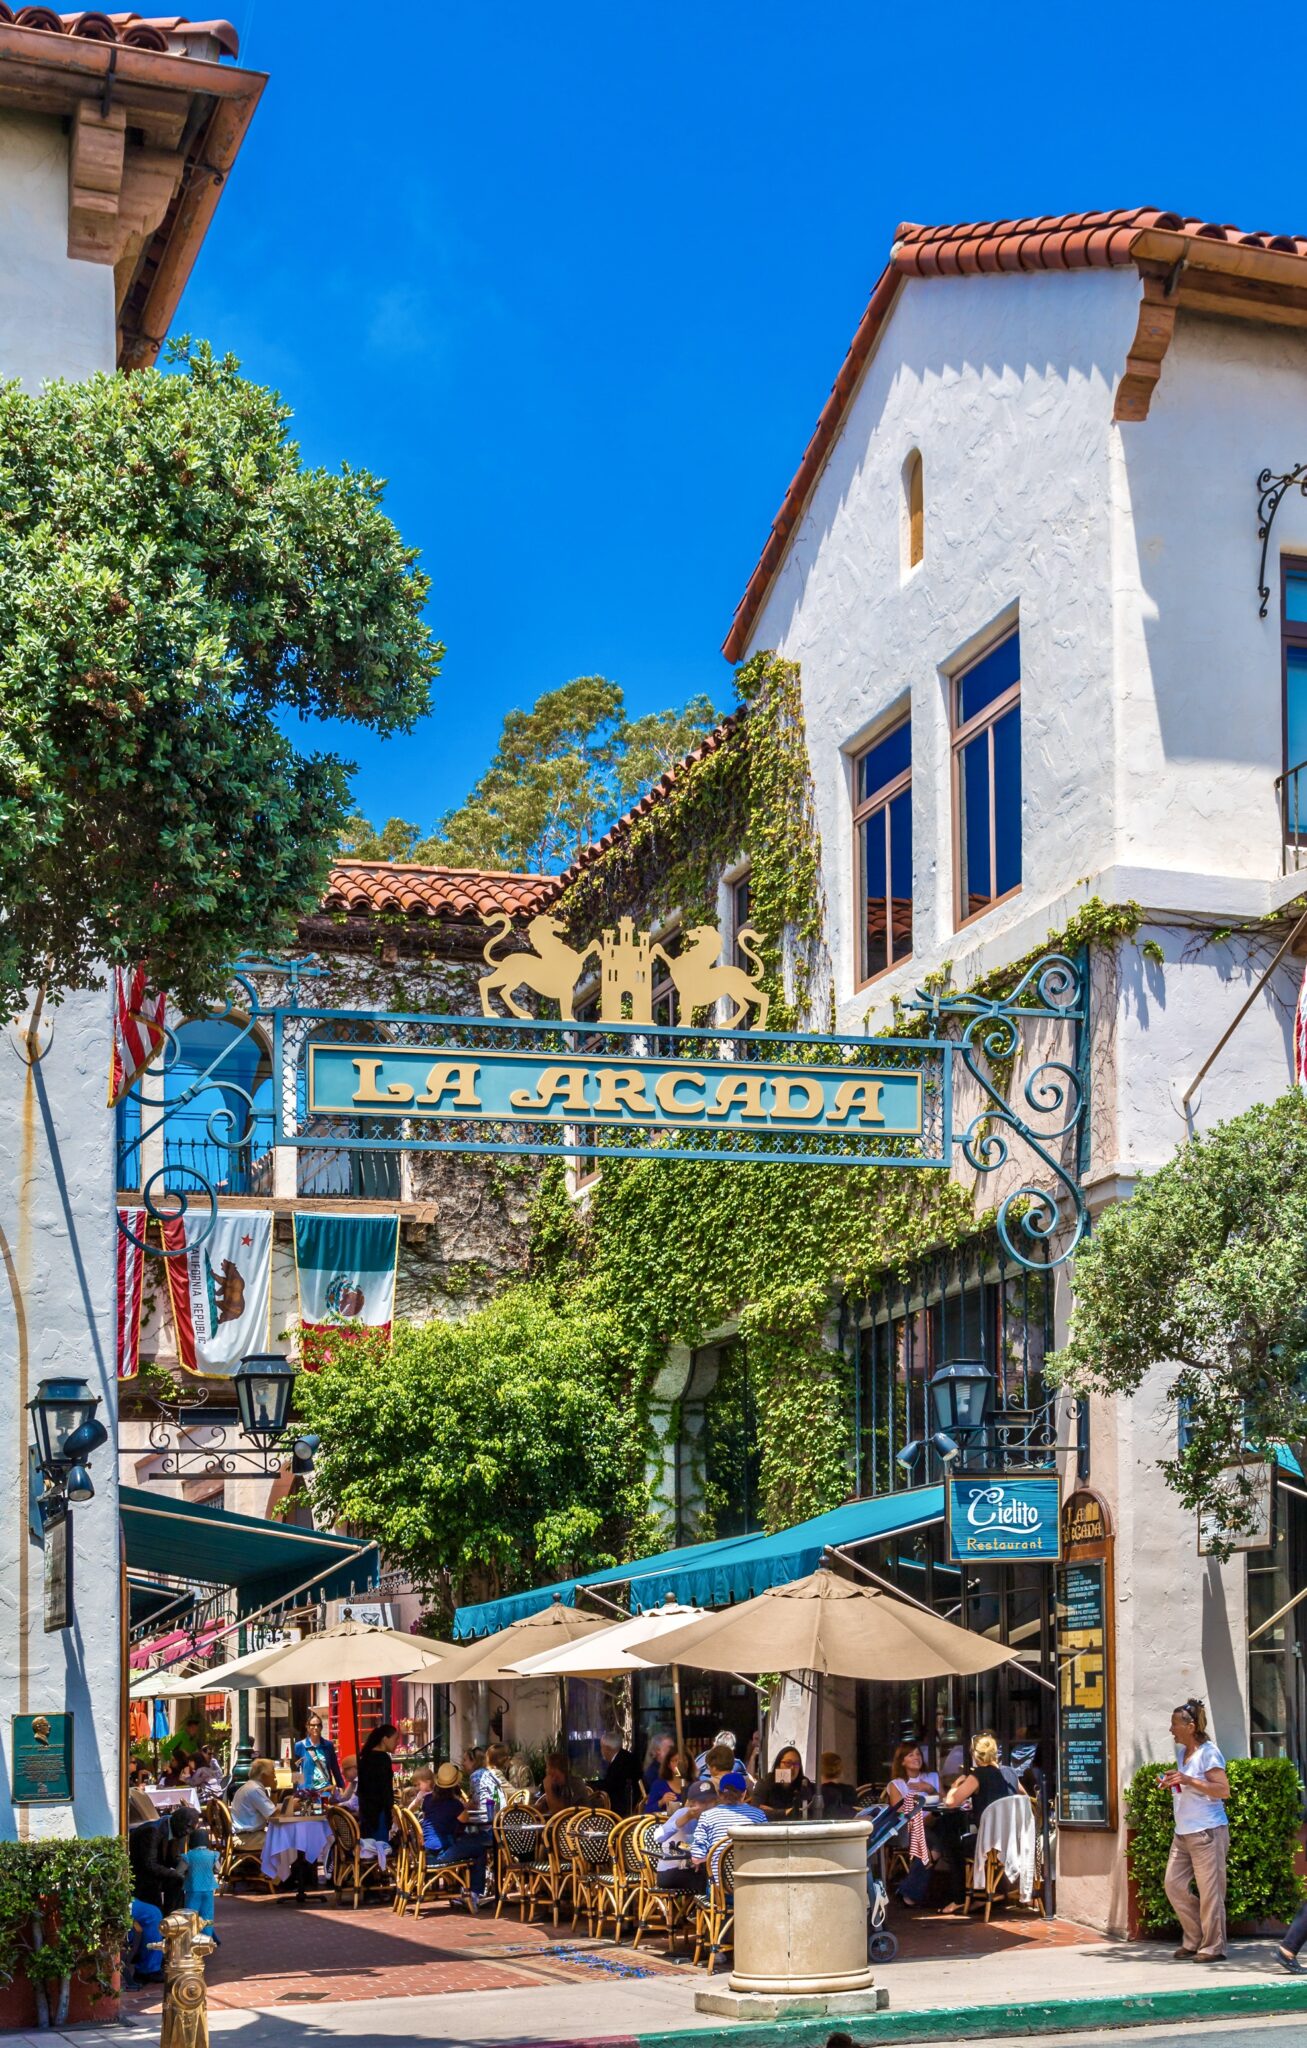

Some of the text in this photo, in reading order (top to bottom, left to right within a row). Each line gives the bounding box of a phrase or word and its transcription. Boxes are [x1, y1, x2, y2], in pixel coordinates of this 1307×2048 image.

[351, 1058, 886, 1122] LA ARCADA
[192, 1303, 207, 1345] REPUBLIC
[967, 1487, 1038, 1527] Cielito
[967, 1537, 1043, 1551] Restaurant
